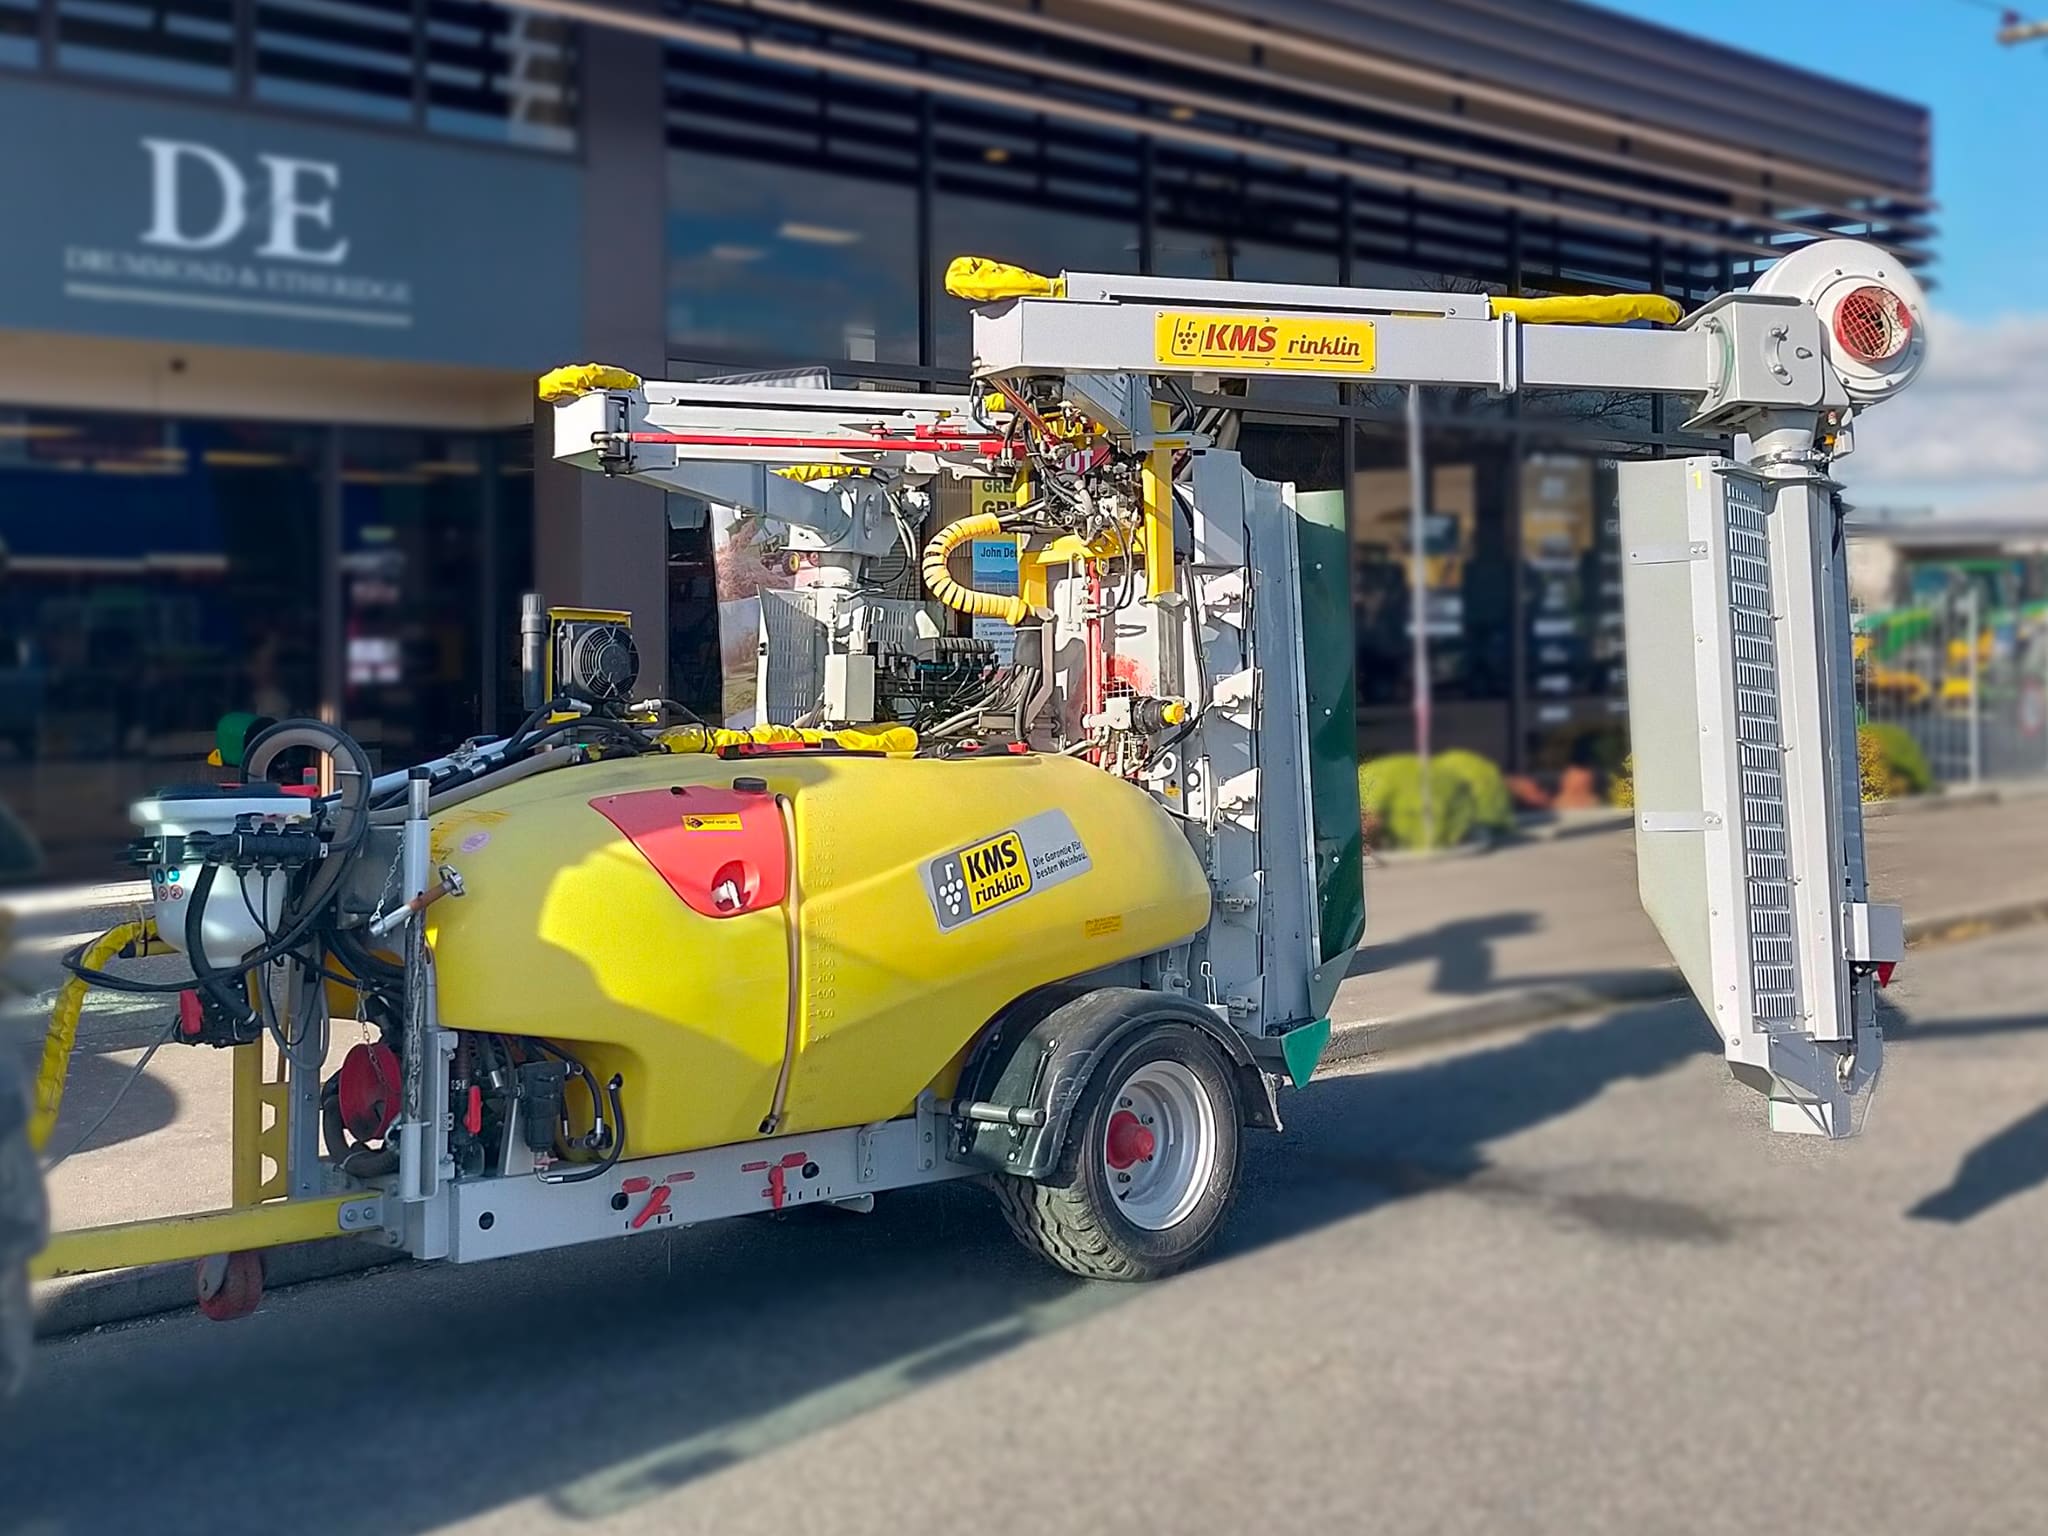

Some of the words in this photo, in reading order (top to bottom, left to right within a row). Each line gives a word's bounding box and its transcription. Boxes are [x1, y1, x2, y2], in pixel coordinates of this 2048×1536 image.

[64, 246, 233, 288] DRUMMOND
[239, 264, 260, 289] &
[266, 268, 411, 303] ETHERIDGE
[1205, 324, 1278, 352] KMS
[1288, 334, 1360, 356] rinklin
[980, 547, 1002, 558] John
[1004, 548, 1017, 558] De
[966, 839, 1017, 883] KMS
[1032, 855, 1045, 868] Die
[1044, 845, 1072, 862] Garantie
[1035, 864, 1059, 880] besten
[975, 871, 1024, 905] rinklin
